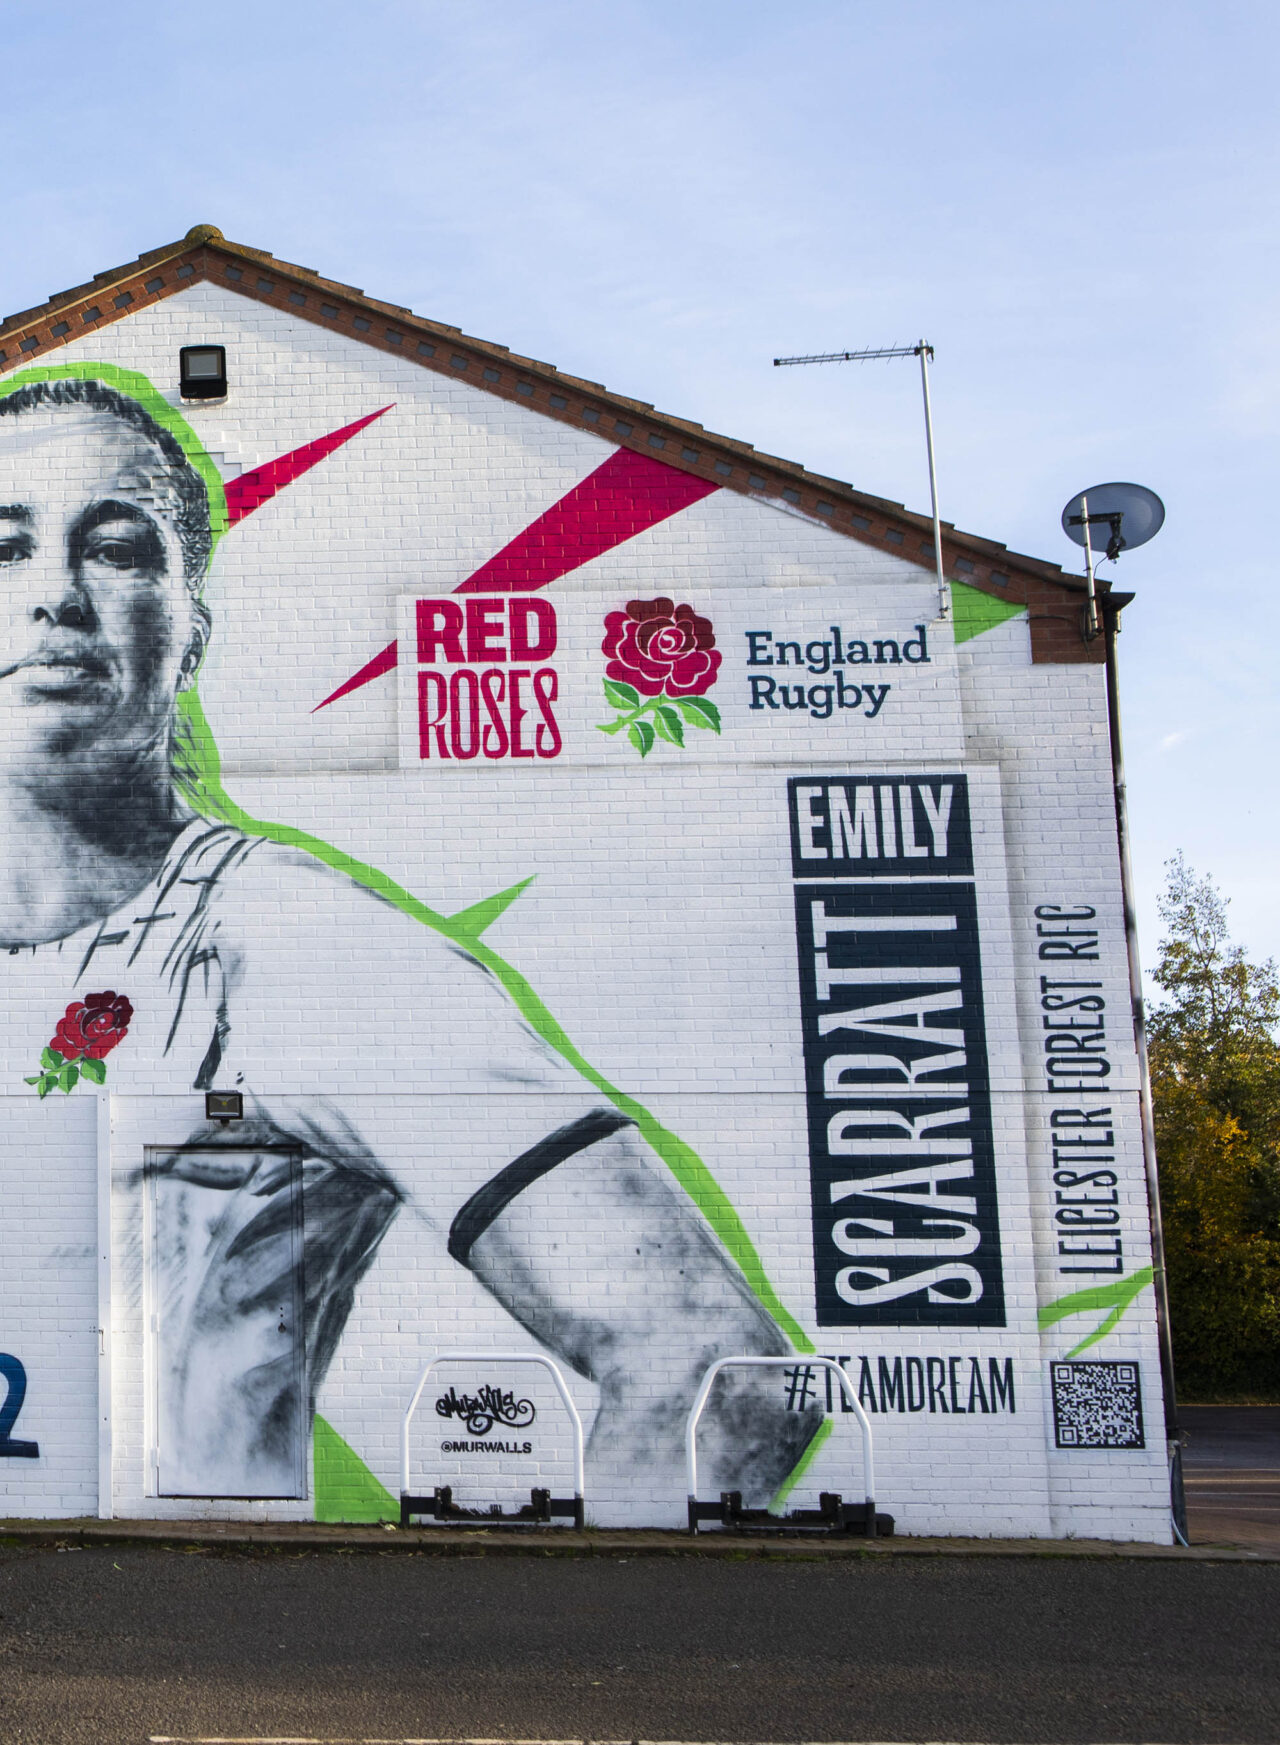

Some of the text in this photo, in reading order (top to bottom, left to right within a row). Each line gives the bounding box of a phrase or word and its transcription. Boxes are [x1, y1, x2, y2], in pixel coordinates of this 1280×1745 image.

[416, 597, 558, 663] RED
[745, 624, 931, 674] England
[418, 667, 563, 760] ROSES
[747, 670, 891, 719] Rugby
[796, 784, 954, 859] EMILY
[811, 900, 984, 1307] SCARRATT
[1034, 905, 1124, 1274] LEICESTER FOREST RFC
[783, 1356, 1016, 1413] #TEAMDREAM
[441, 1441, 532, 1453] @MURWALLS
